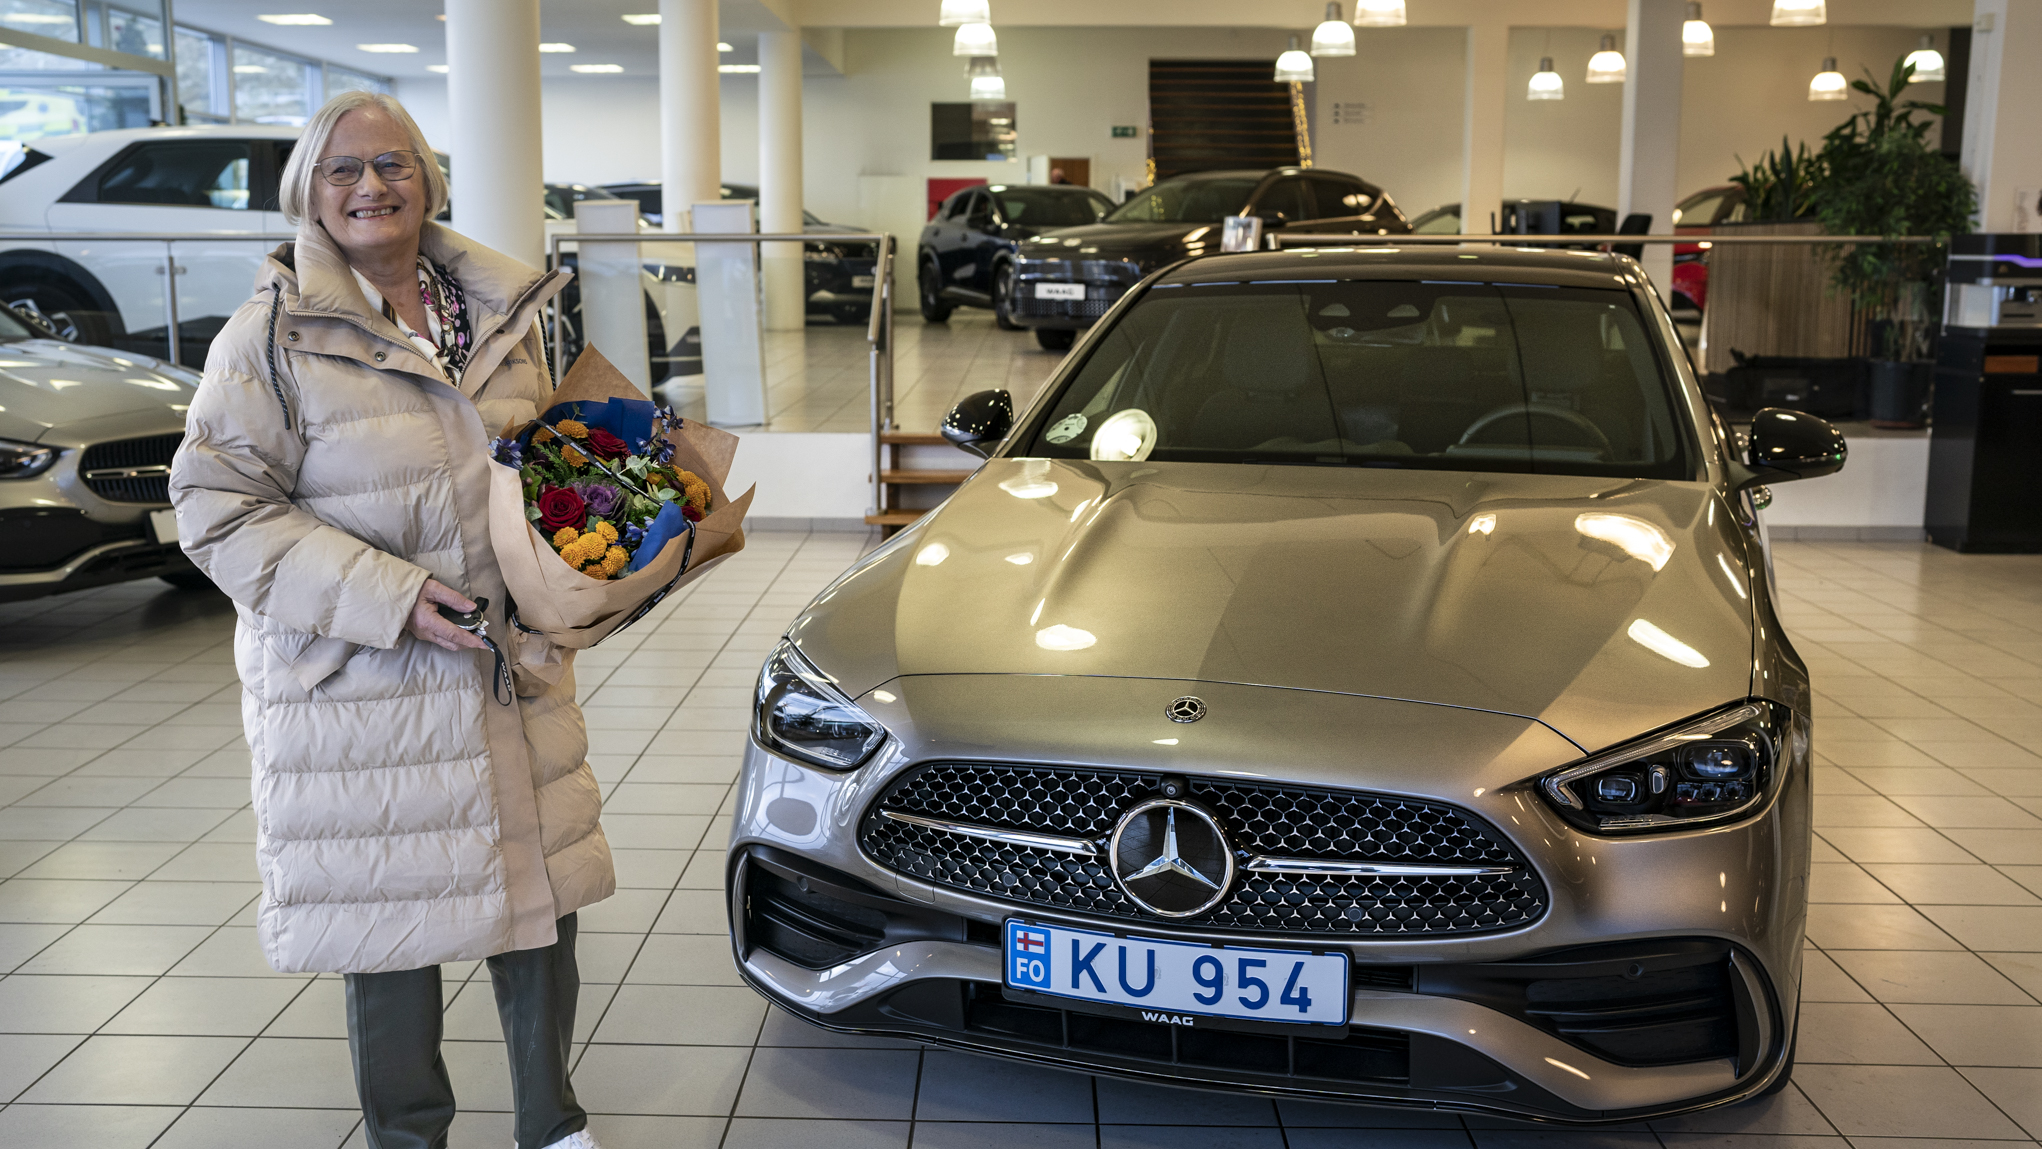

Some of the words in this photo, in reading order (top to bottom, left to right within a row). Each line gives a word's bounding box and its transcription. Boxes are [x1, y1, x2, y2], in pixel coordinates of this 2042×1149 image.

[1016, 957, 1045, 983] FO
[1071, 938, 1156, 998] KU
[1192, 954, 1312, 1014] 954
[1141, 1011, 1194, 1026] WAAG
